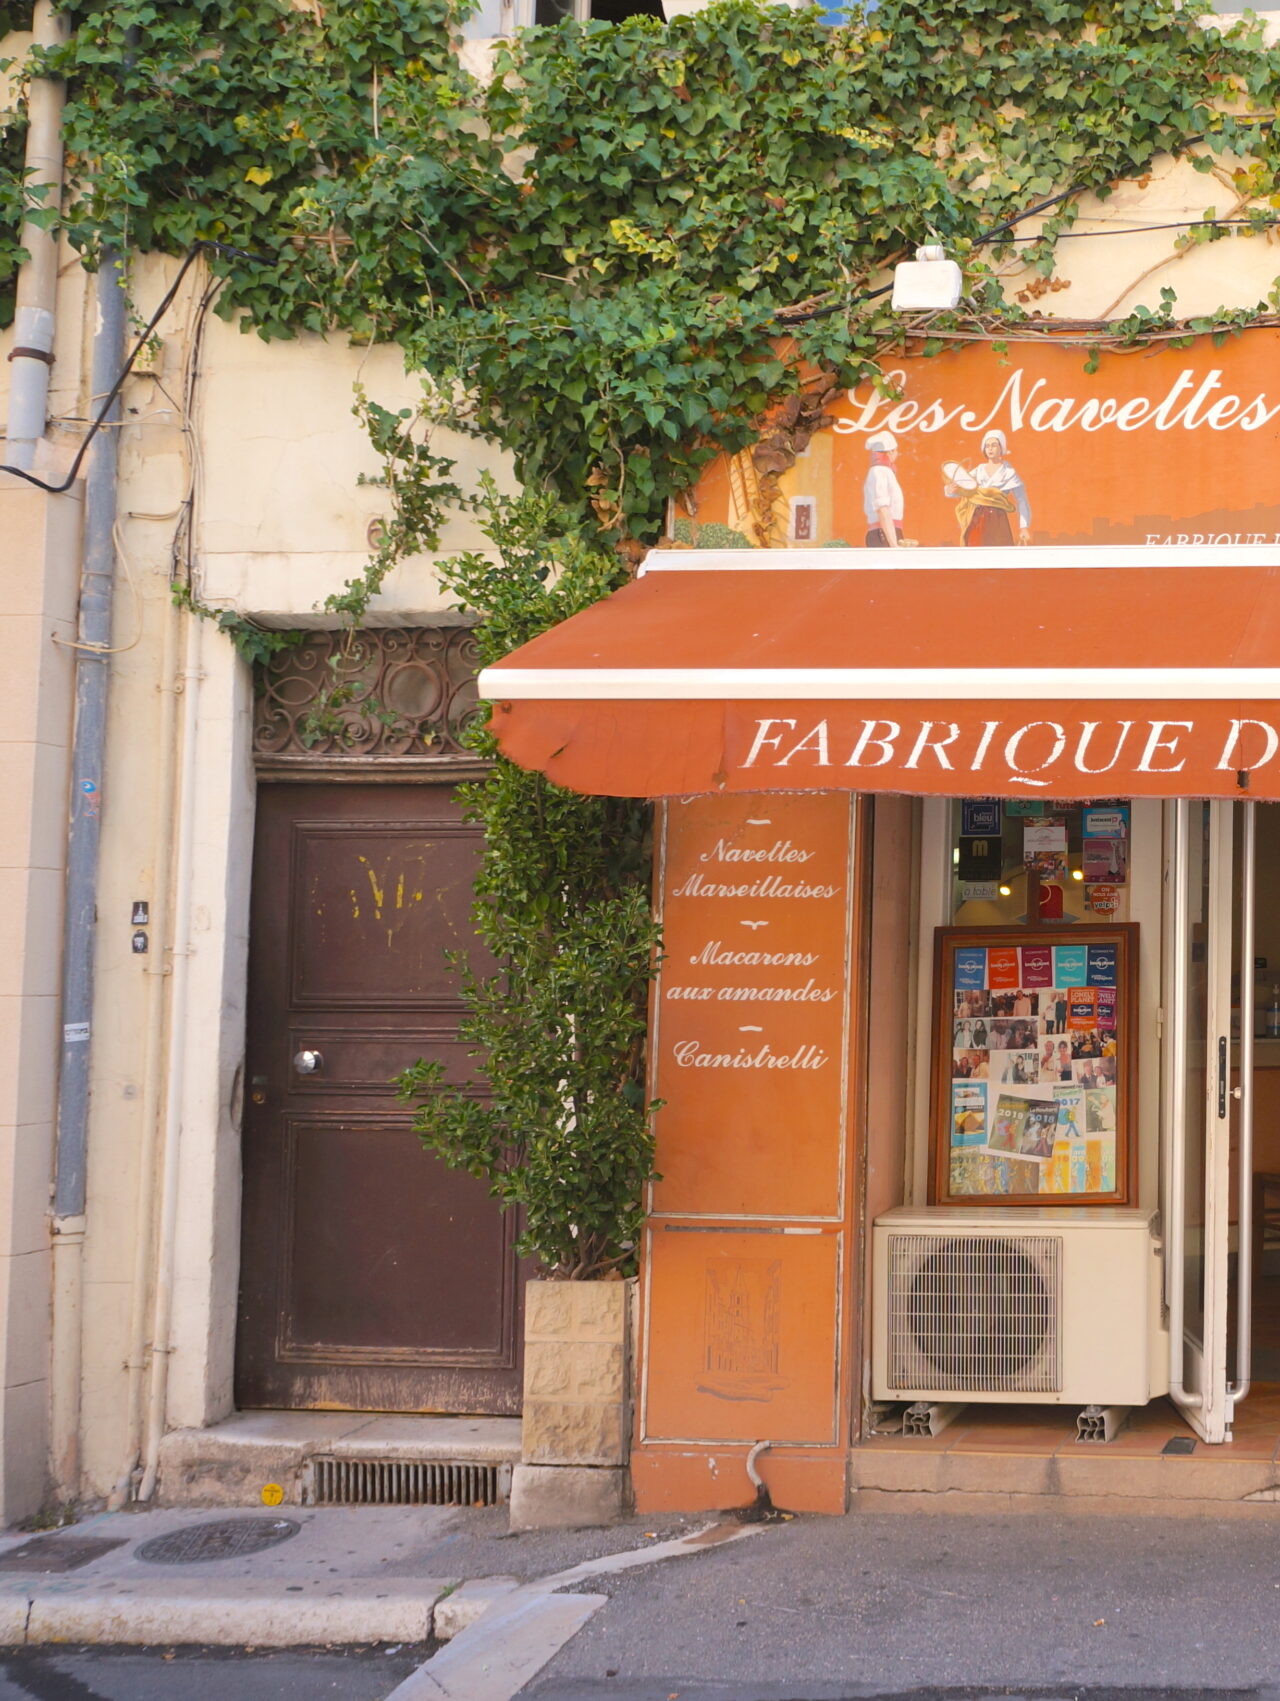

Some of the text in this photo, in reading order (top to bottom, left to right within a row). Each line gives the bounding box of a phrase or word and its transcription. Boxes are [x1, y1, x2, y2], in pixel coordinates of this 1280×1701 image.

[832, 369, 966, 434] Les
[738, 718, 1194, 786] FABRIQUE
[700, 838, 816, 863] Navettes
[672, 873, 841, 898] Marseillaises
[1094, 901, 1111, 910] yelp
[689, 940, 819, 966] Macarons
[666, 979, 838, 1002] aux amandes
[673, 1040, 829, 1070] Canistrelli
